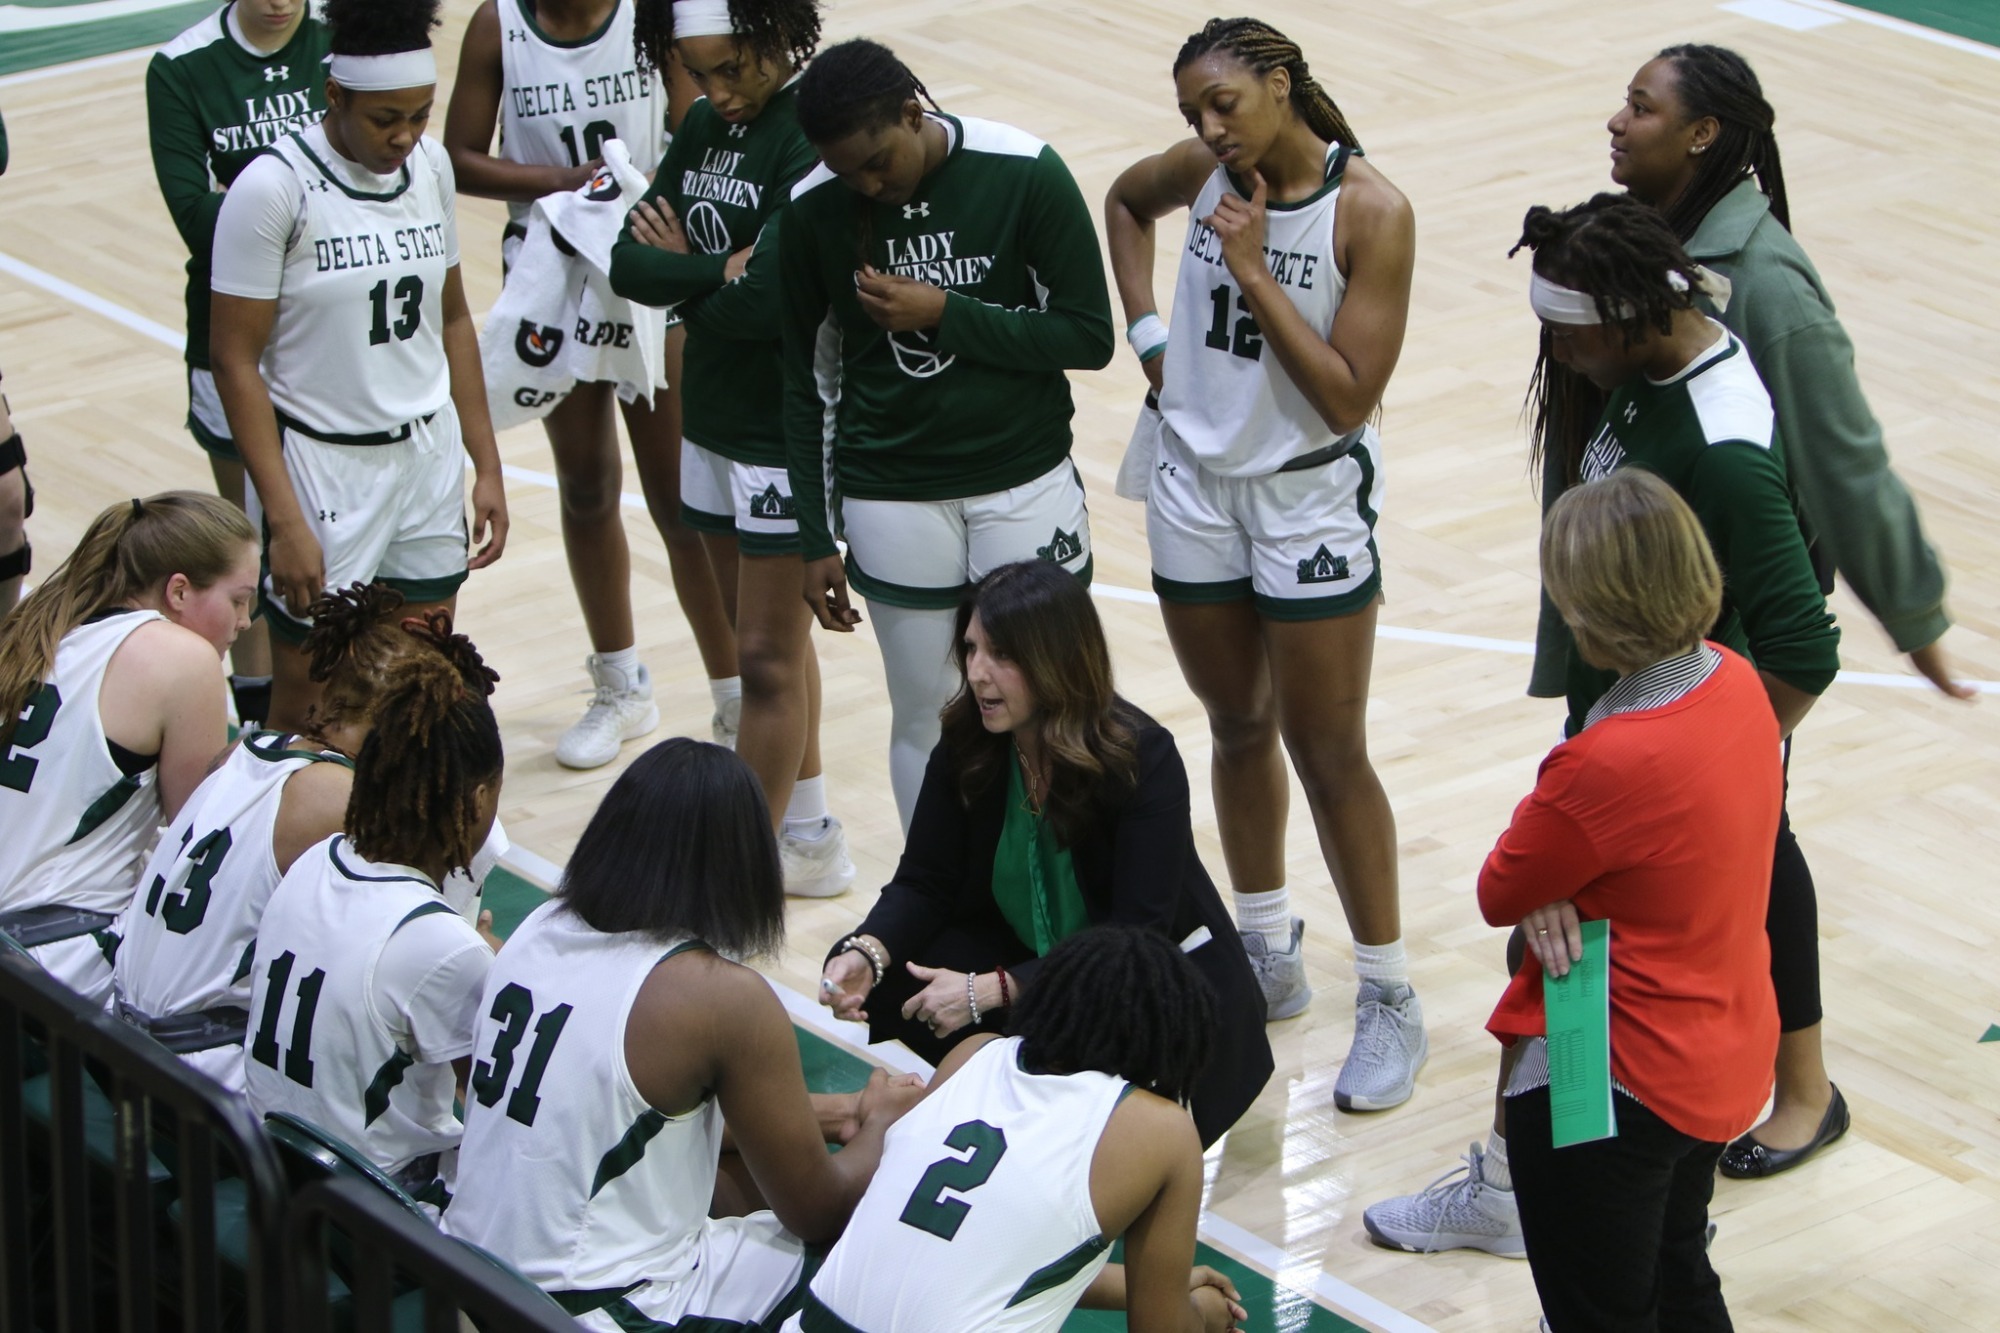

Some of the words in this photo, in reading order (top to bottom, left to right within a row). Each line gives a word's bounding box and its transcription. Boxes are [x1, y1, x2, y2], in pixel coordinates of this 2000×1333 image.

[245, 87, 311, 124] LADY
[512, 82, 576, 118] DELTA
[585, 70, 650, 108] STATE
[700, 147, 746, 176] LADY
[315, 232, 391, 272] DELTA
[395, 223, 445, 261] STATE
[886, 231, 955, 266] LADY
[369, 274, 424, 346] 13
[1205, 283, 1263, 362] 12
[252, 949, 326, 1089] 11
[472, 981, 574, 1127] 31
[898, 1119, 1008, 1242] 2
